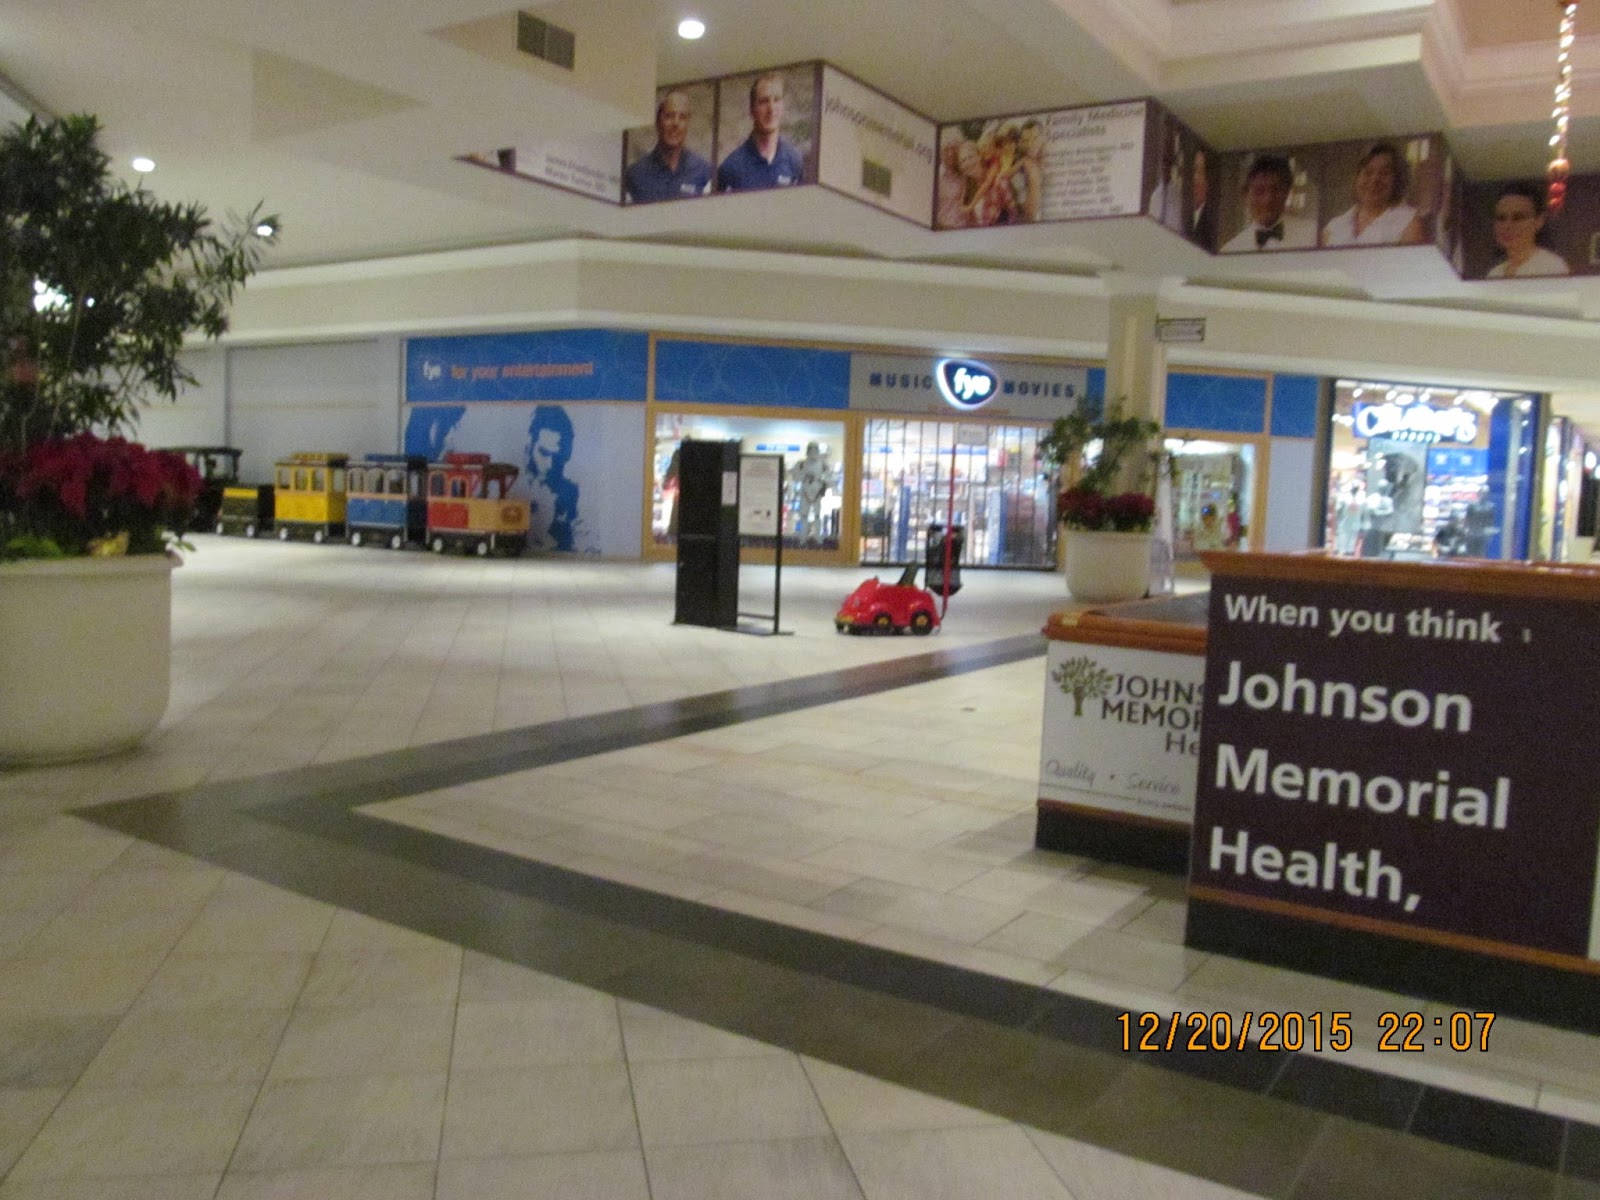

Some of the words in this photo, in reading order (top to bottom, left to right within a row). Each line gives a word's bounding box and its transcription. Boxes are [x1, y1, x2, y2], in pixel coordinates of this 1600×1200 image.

[502, 361, 593, 378] entertainment
[869, 371, 933, 390] MUSIC
[953, 367, 992, 400] fye
[1003, 379, 1075, 398] MOVIES
[1224, 594, 1320, 628] When
[1329, 607, 1396, 638] you
[1406, 607, 1503, 643] think
[1115, 673, 1203, 706] JOHN
[1217, 660, 1473, 733] Johnson
[1045, 758, 1097, 787] Quality
[1127, 772, 1181, 796] Service
[1215, 743, 1511, 830] Memorial
[1209, 826, 1422, 913] Health,
